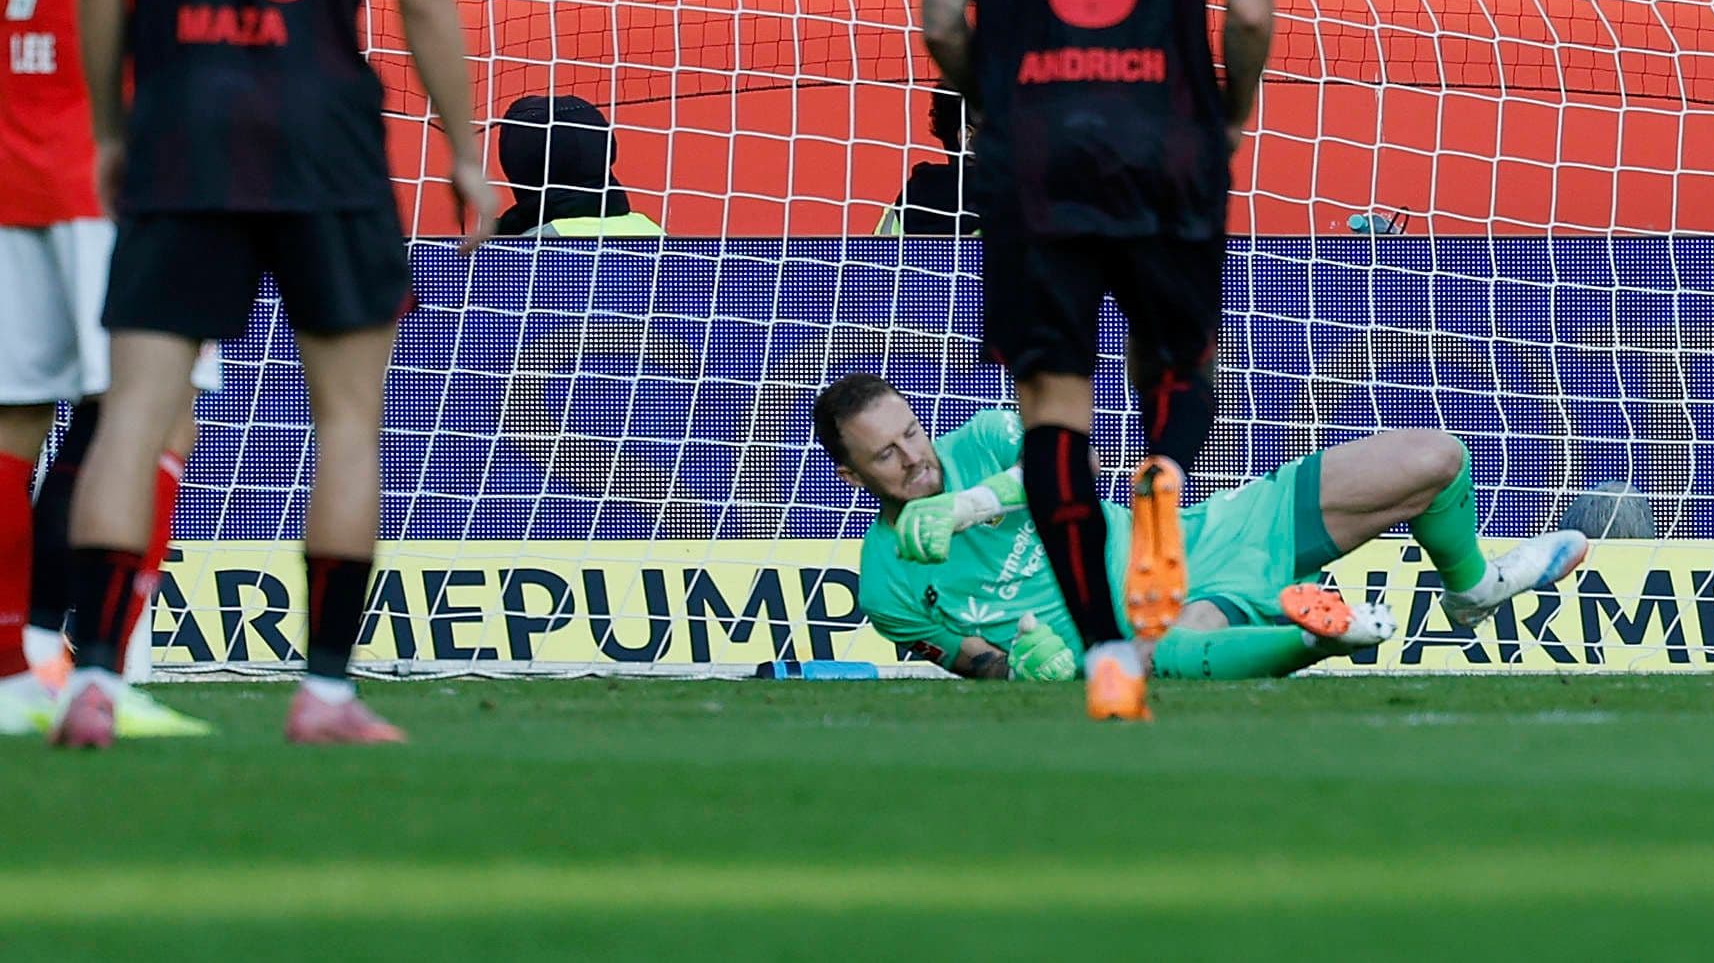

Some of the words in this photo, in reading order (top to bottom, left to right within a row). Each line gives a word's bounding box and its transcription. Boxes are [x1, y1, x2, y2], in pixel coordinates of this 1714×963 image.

[10, 32, 58, 75] LEE
[1017, 48, 1167, 85] ANDRICH
[151, 547, 915, 663] ÄRMEPUMP
